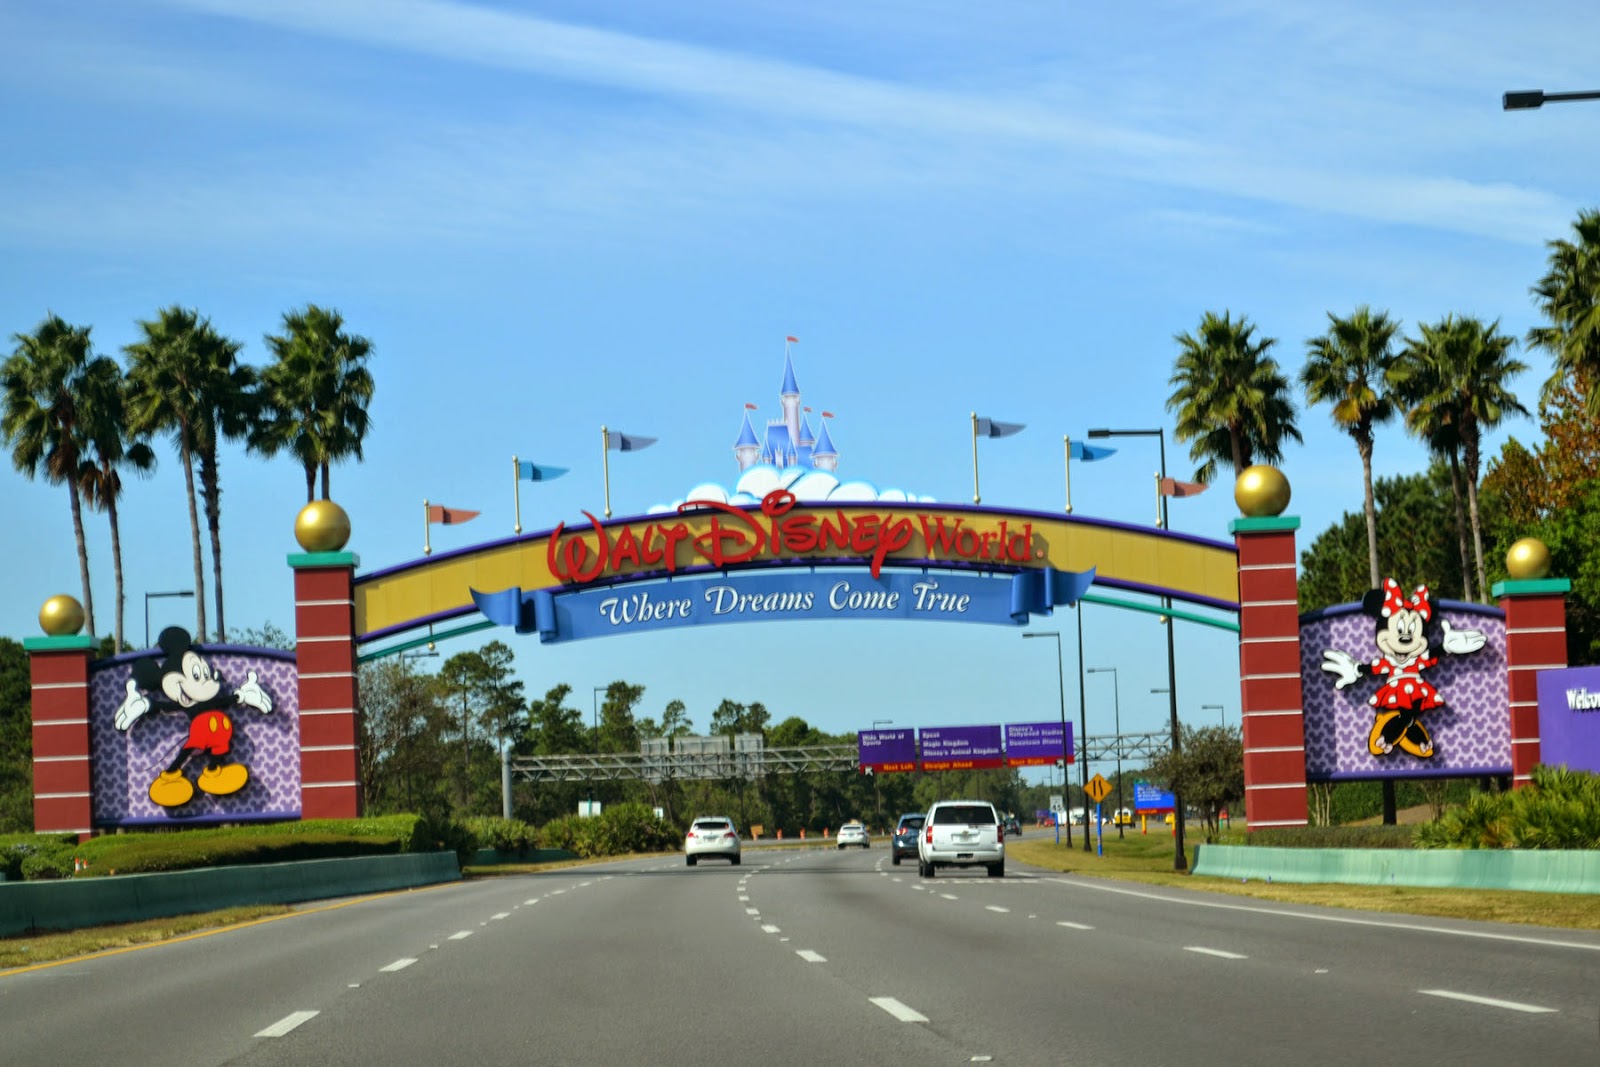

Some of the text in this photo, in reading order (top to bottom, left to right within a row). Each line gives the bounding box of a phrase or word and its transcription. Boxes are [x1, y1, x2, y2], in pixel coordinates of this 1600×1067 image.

[599, 580, 971, 627] Where Dreams Come True
